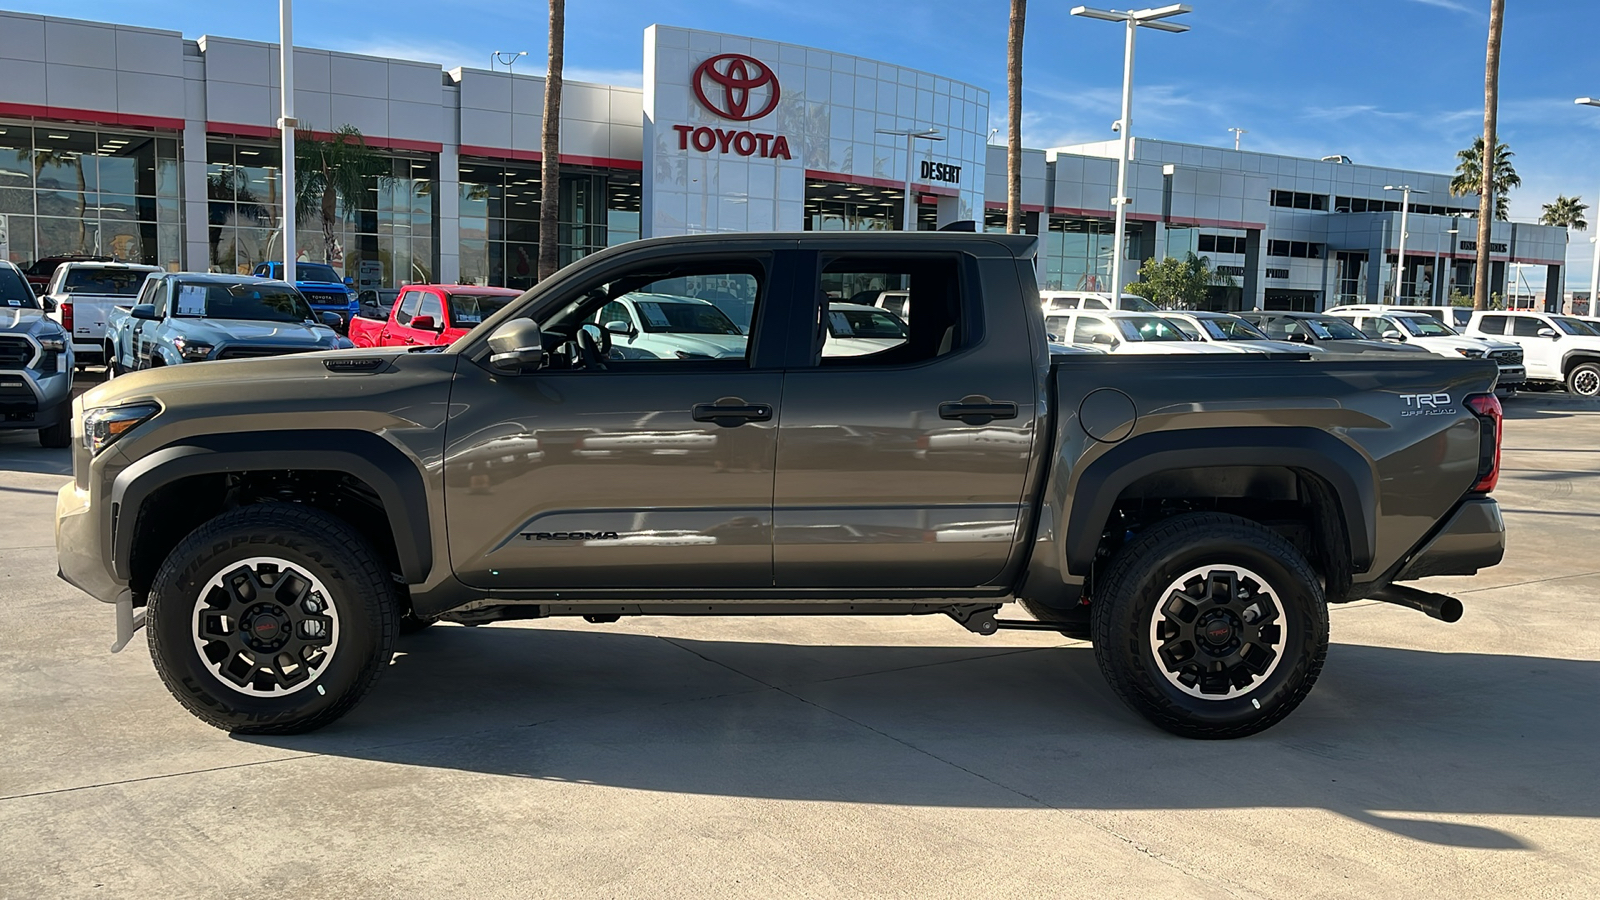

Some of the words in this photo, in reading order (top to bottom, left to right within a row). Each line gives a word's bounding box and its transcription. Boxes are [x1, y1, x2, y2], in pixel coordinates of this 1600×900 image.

[673, 125, 792, 160] TOYOTA
[921, 160, 961, 183] DESERT
[1400, 393, 1451, 409] TRD
[520, 531, 619, 541] TACOMA
[175, 535, 304, 592] WILDPEAK
[1209, 627, 1228, 637] TRD
